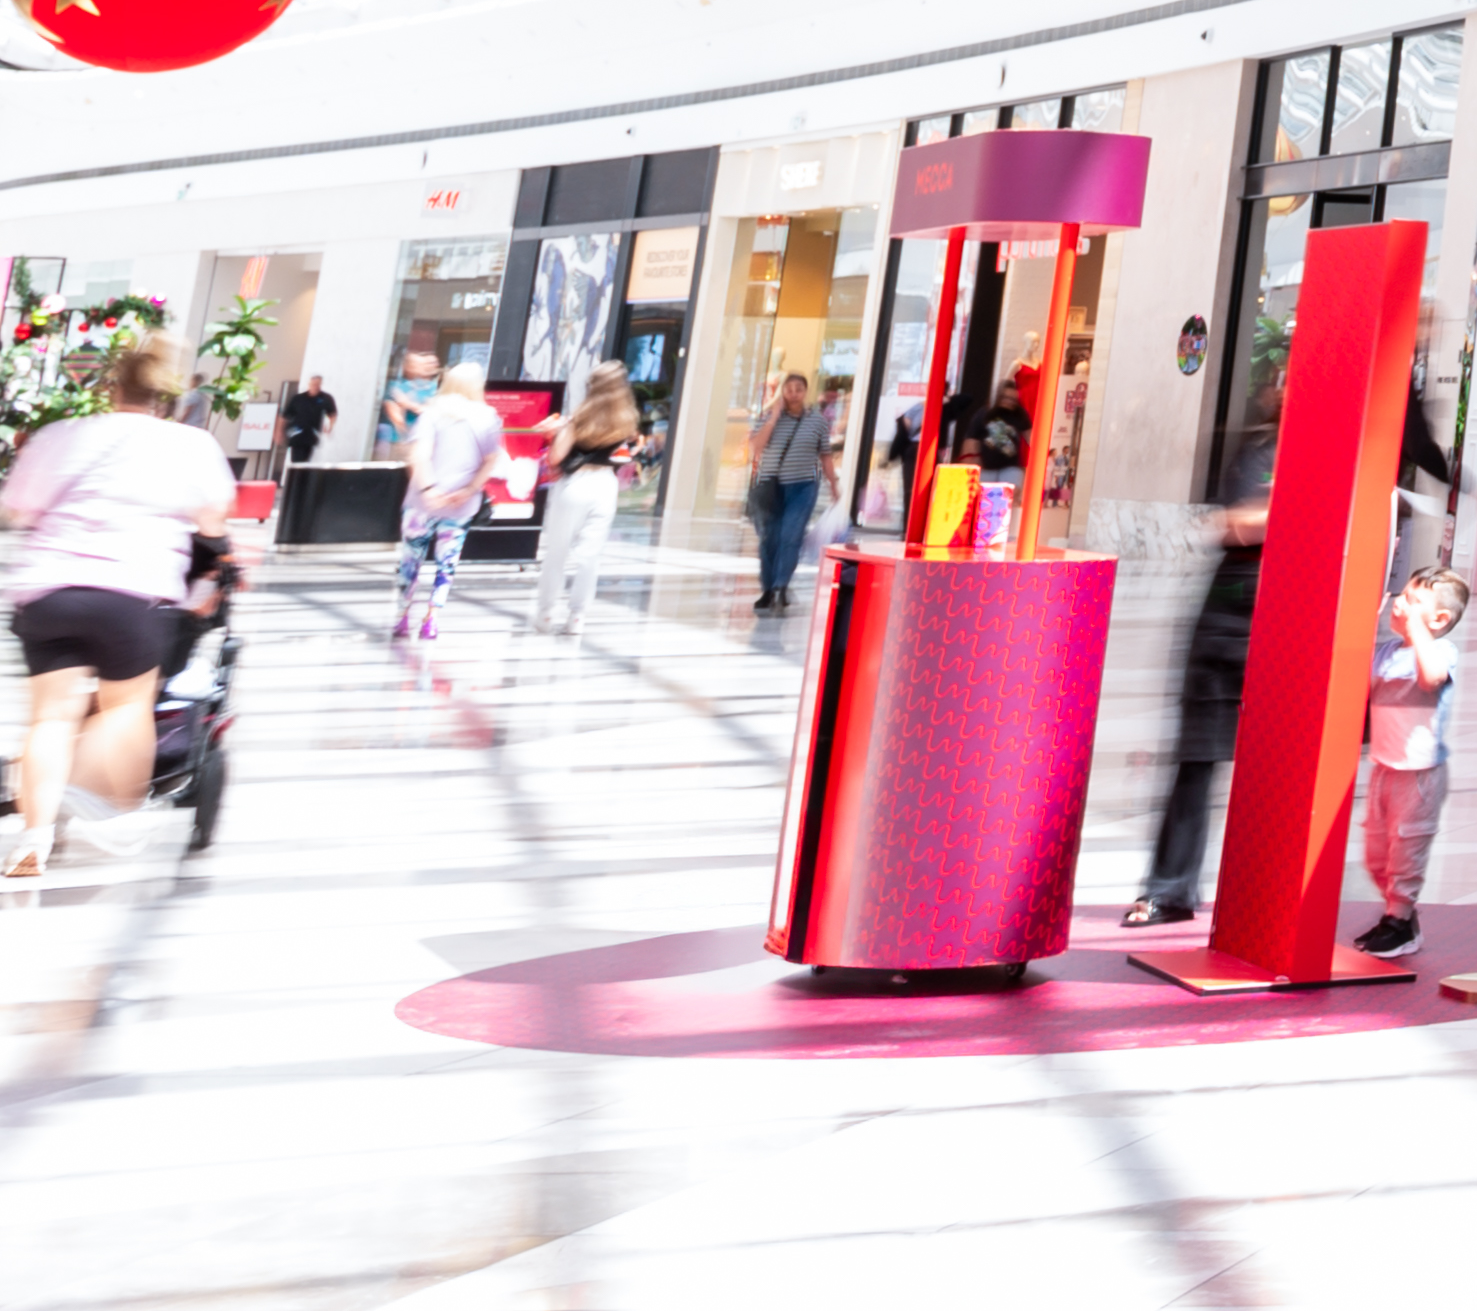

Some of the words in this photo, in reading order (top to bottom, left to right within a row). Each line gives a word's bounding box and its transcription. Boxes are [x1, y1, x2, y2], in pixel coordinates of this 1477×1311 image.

[915, 162, 954, 195] MECCA
[425, 190, 460, 210] H&M
[243, 422, 271, 431] SALE
